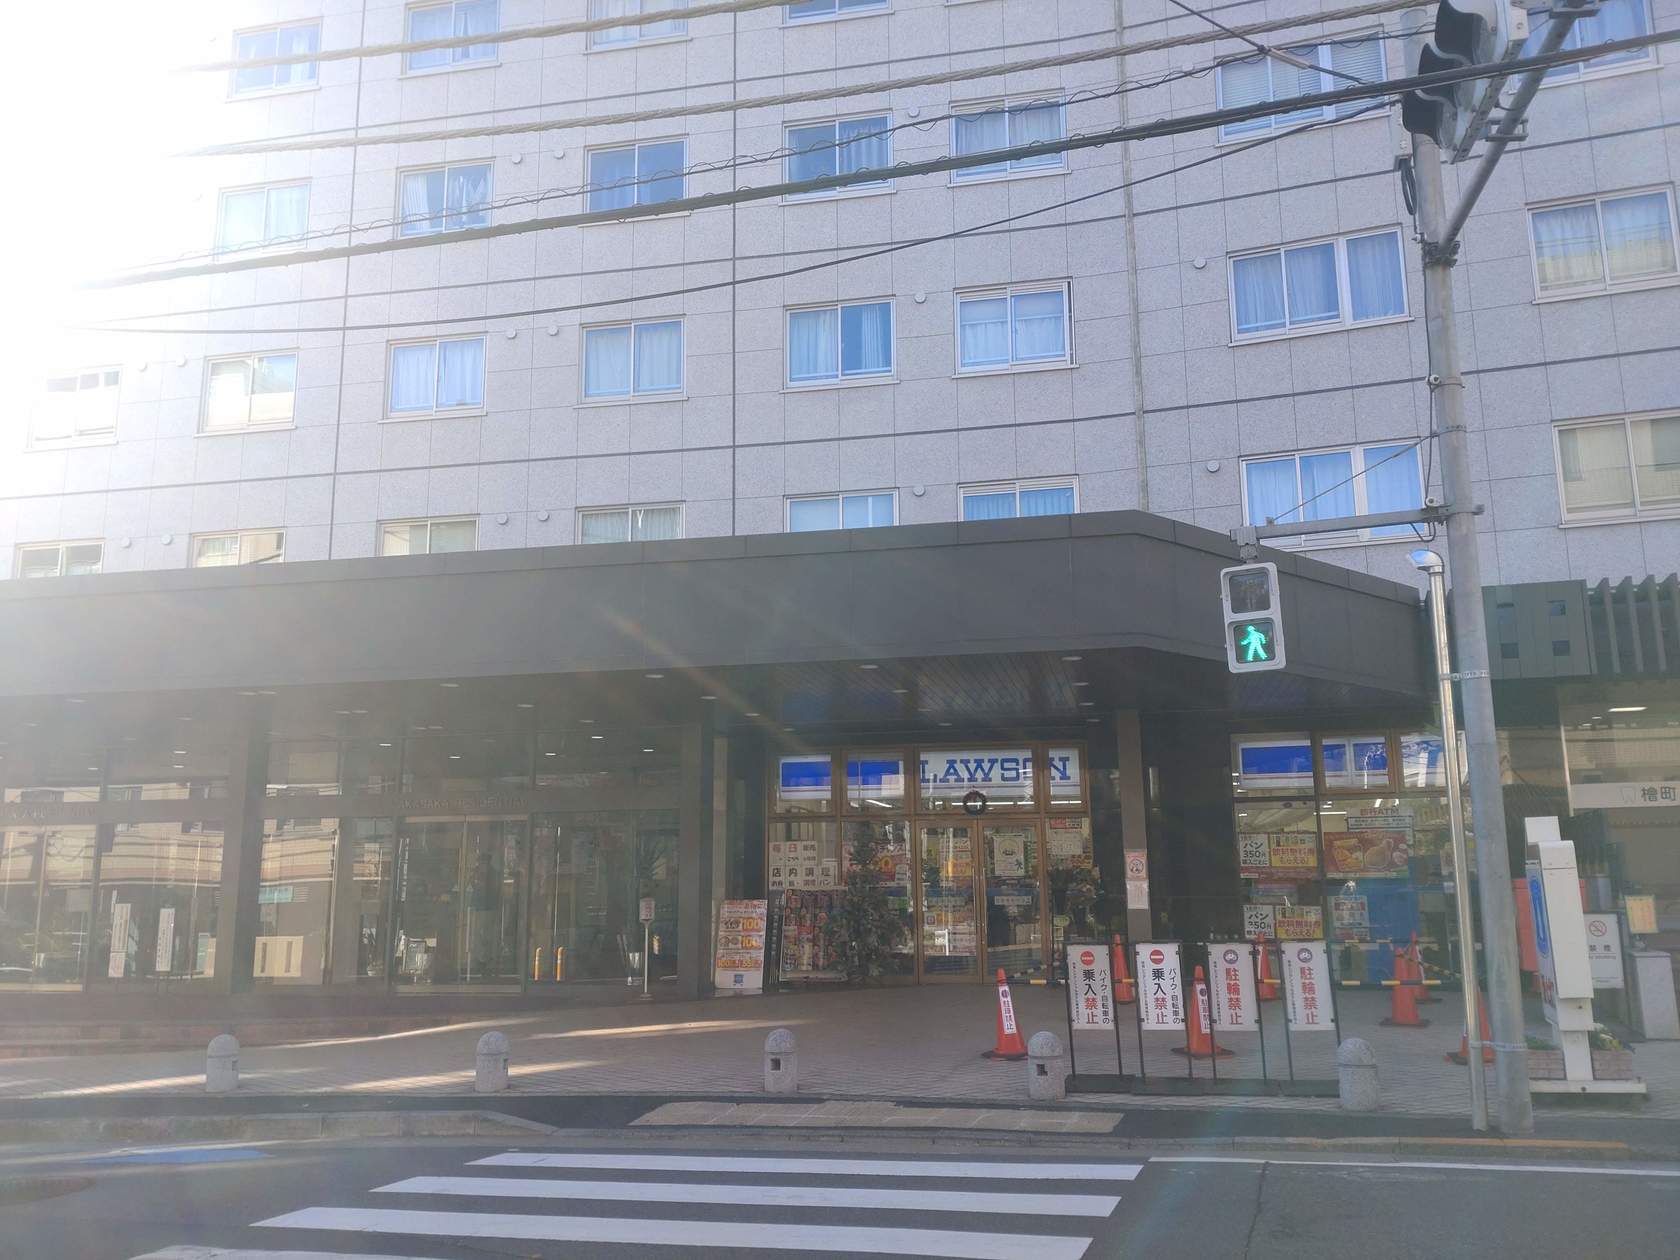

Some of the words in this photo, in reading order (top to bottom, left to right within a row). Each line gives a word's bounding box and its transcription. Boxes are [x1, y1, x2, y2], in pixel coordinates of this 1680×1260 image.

[1082, 968, 1099, 1025] 乗入禁止
[1151, 967, 1169, 1025] 乗入禁止
[1225, 967, 1244, 1025] 駐輪禁止
[1300, 966, 1320, 1025] 駐輪禁止
